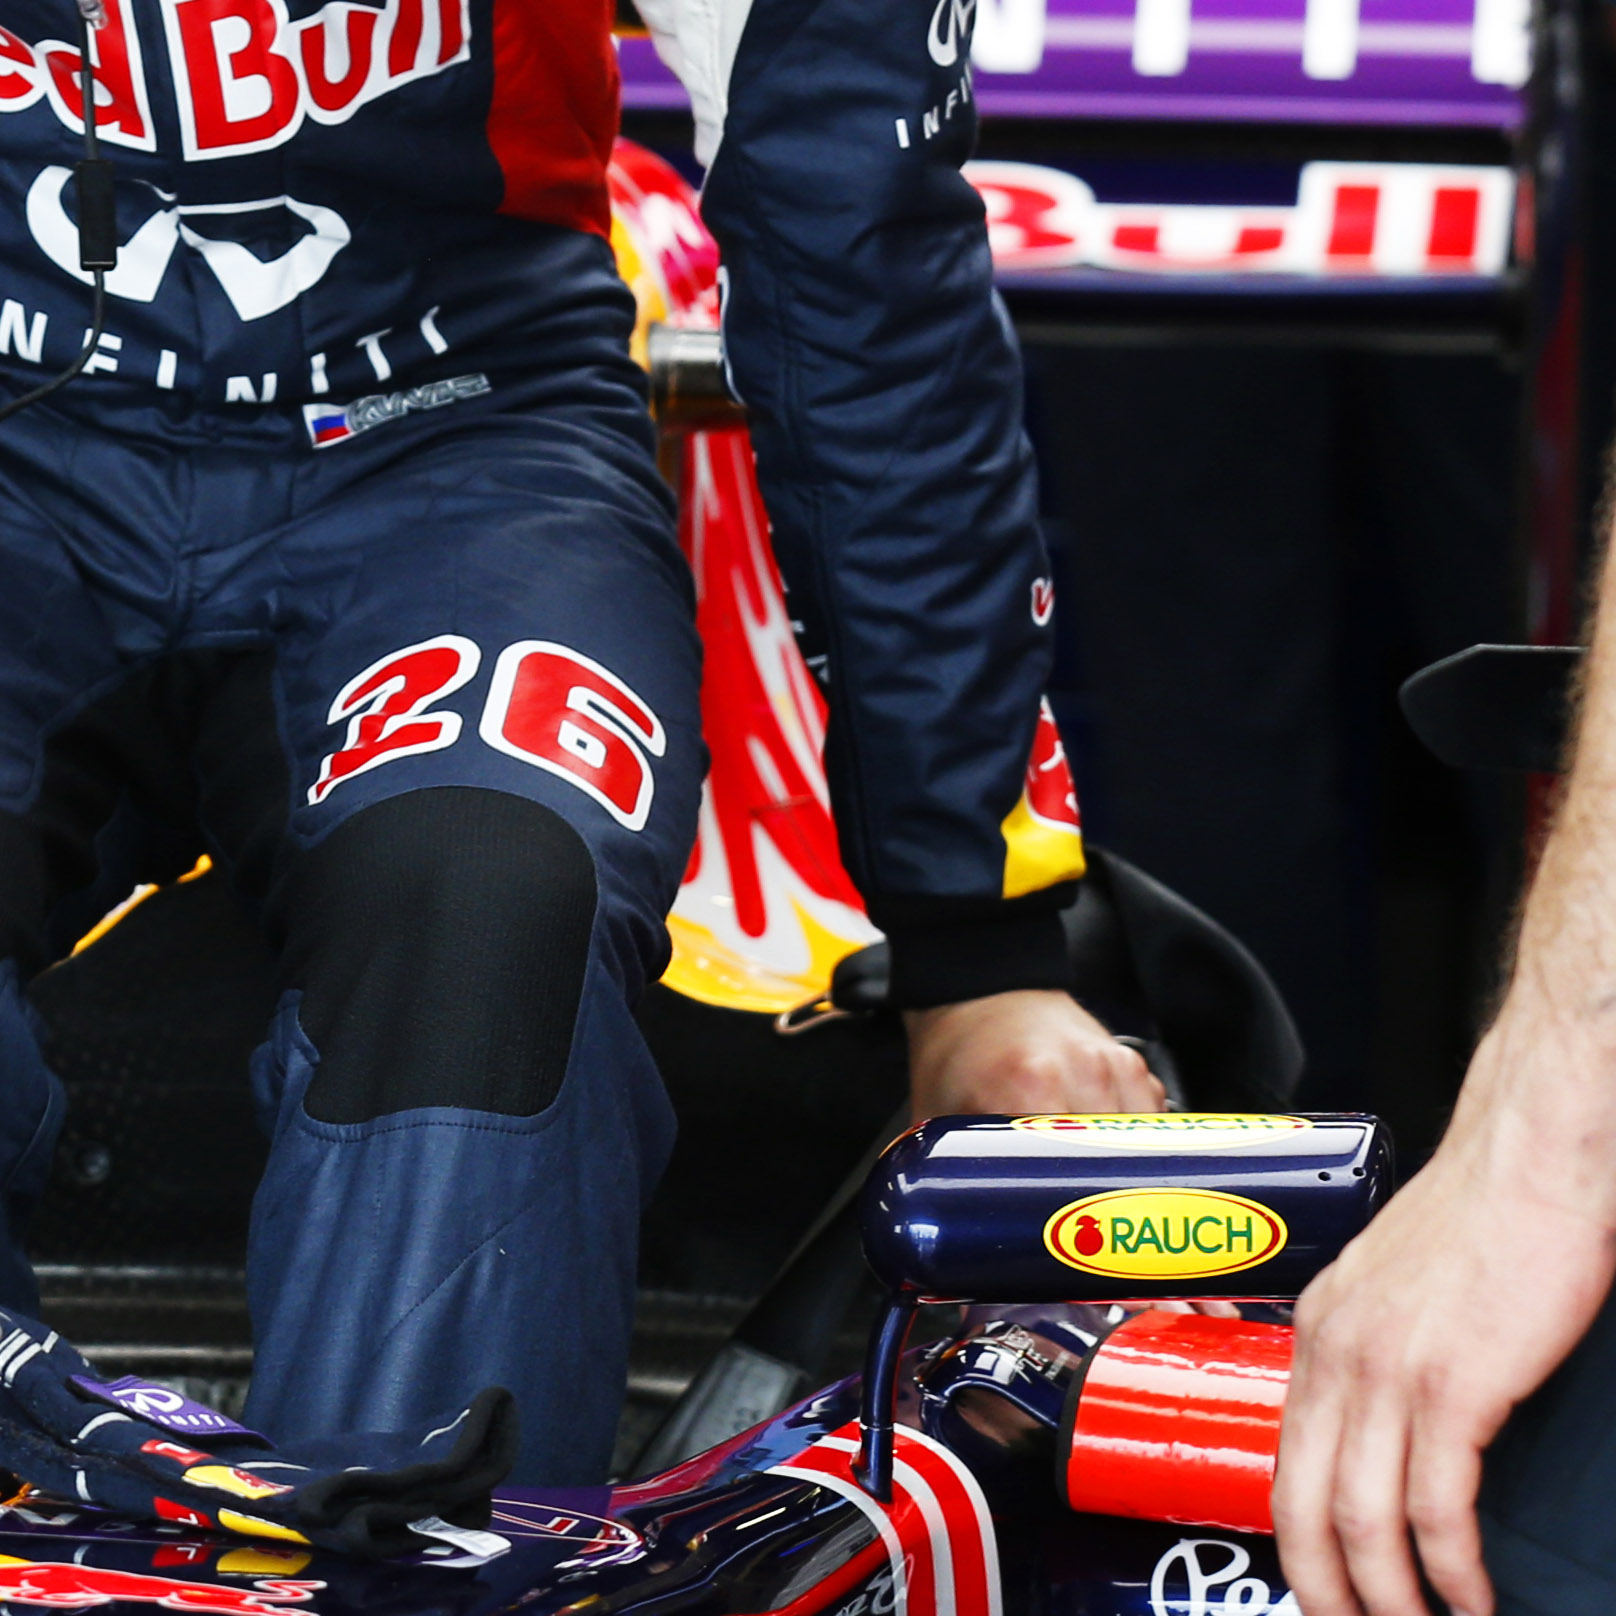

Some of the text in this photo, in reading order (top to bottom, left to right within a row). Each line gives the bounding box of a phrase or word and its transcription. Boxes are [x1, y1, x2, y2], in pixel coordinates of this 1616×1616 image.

[964, 160, 1518, 277] Bull
[308, 634, 666, 831] 26
[1109, 1216, 1254, 1255] RAUCH
